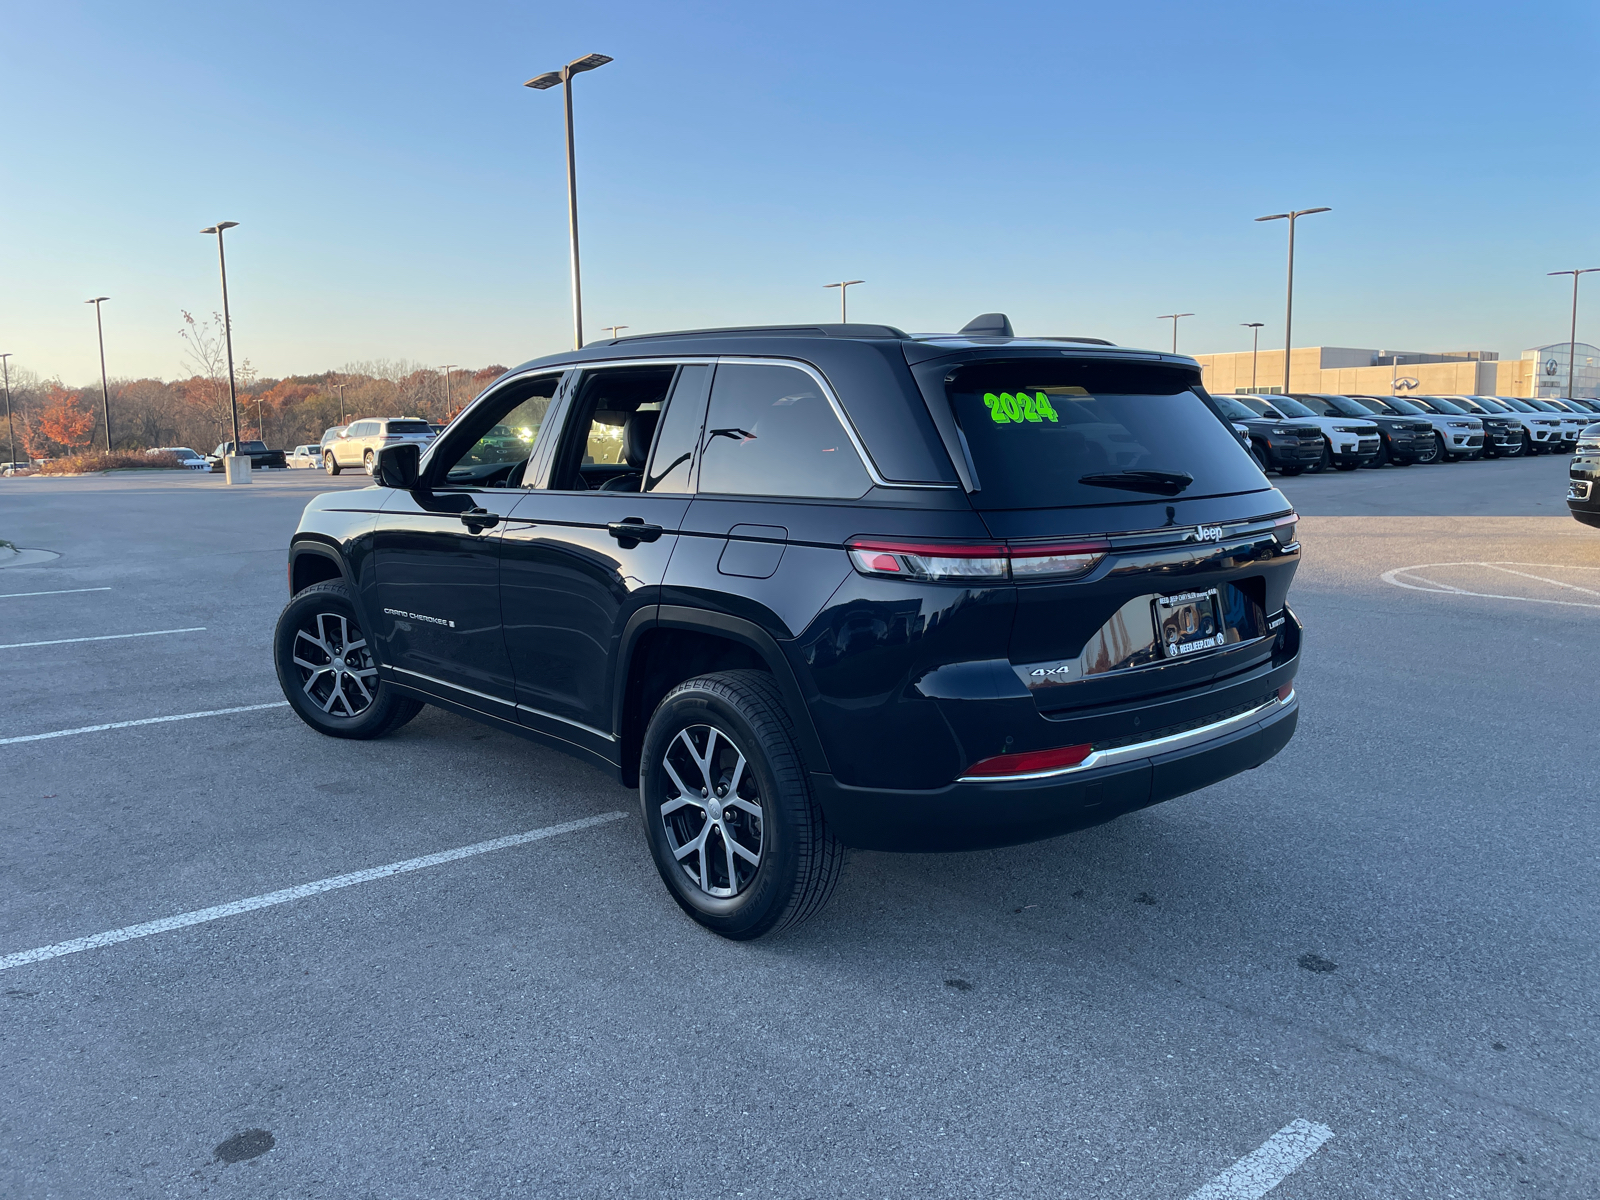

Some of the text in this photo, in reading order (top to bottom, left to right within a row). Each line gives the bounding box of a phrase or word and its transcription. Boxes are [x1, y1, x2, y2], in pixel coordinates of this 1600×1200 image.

[983, 392, 1058, 423] 2024
[1194, 525, 1223, 542] Jeep
[384, 608, 448, 626] GRAND CHEROKEE
[1180, 637, 1215, 653] REEDJEEP.COM
[1031, 665, 1069, 676] 4x4
